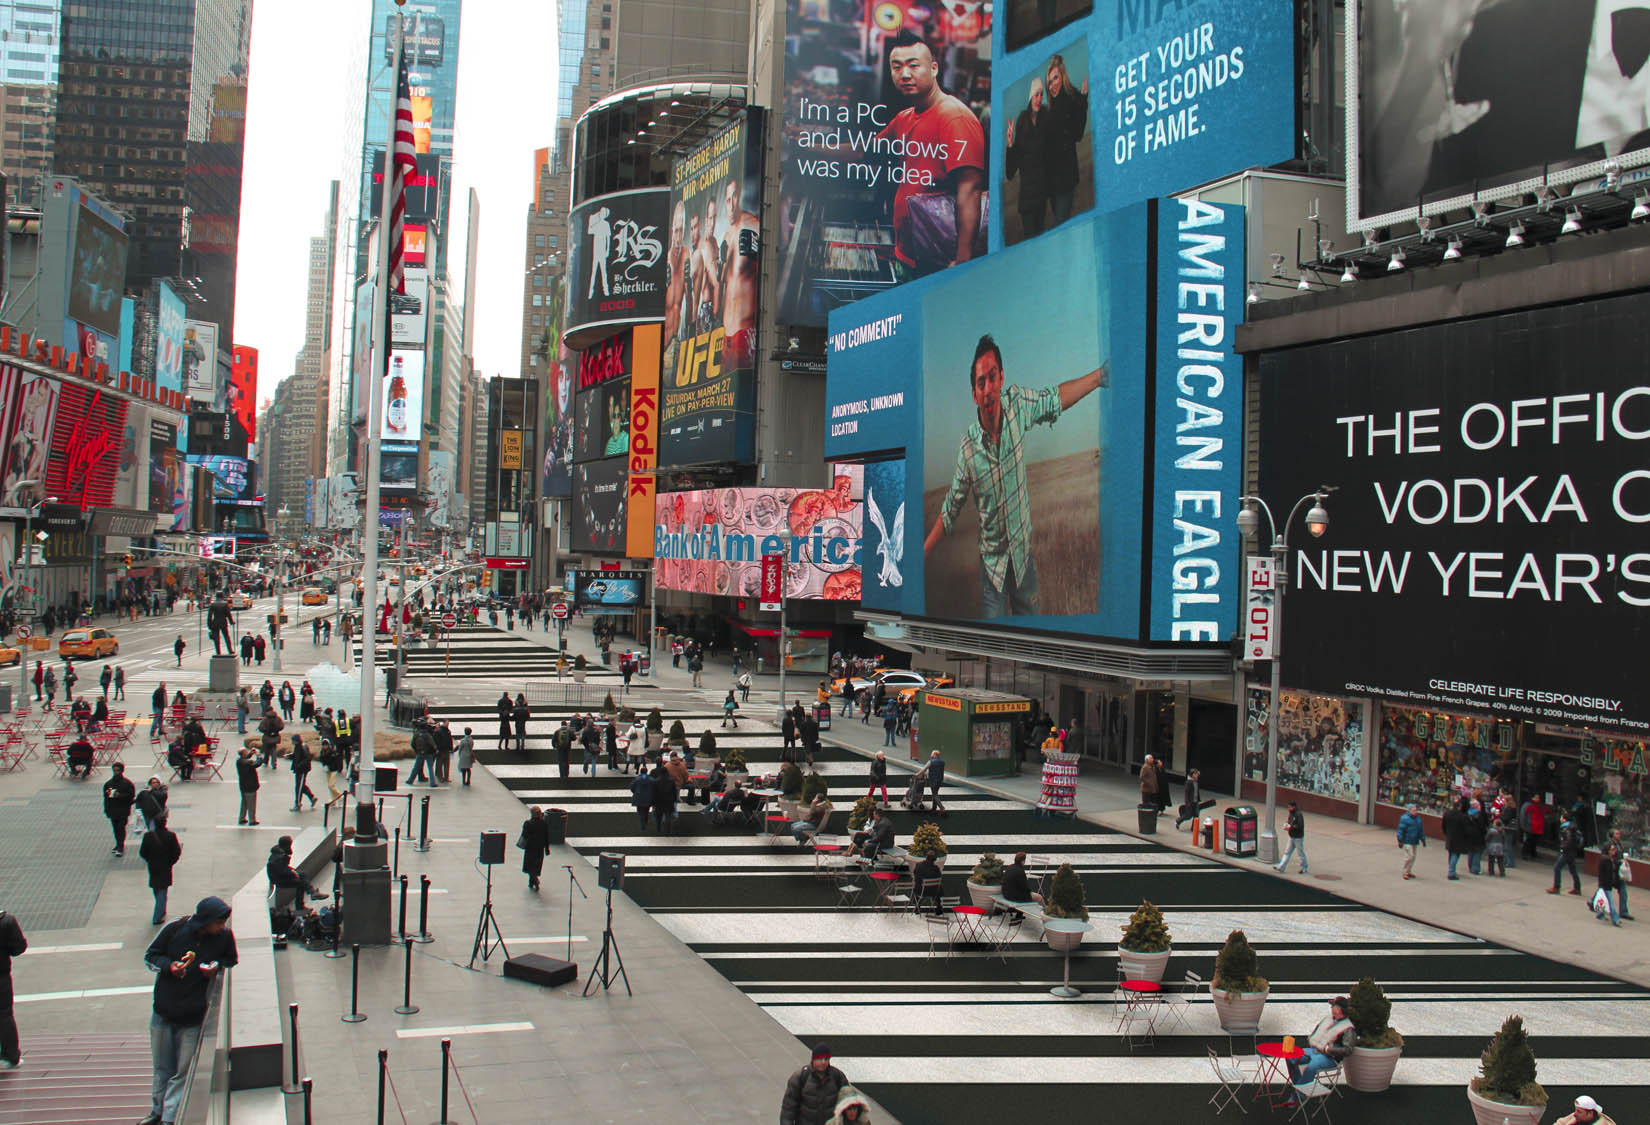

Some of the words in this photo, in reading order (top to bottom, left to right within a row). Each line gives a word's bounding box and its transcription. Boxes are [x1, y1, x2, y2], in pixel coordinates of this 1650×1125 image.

[1115, 52, 1150, 94] GET
[1157, 22, 1214, 73] YOUR
[1115, 95, 1137, 129] 15
[1144, 46, 1244, 116] SECONDS
[800, 97, 829, 121] I'm
[836, 106, 849, 123] a
[857, 103, 887, 126] PC
[675, 146, 710, 184] ST-PIERRE
[714, 125, 741, 158] HARDY
[797, 128, 840, 150] and
[848, 129, 949, 160] Windows
[954, 139, 968, 161] 7
[1114, 131, 1137, 165] OF
[1144, 104, 1206, 154] FAME.
[682, 180, 697, 201] MIR
[700, 157, 730, 191] CARWIN
[797, 159, 840, 178] was
[847, 163, 882, 187] my
[887, 161, 936, 187] idea.
[612, 281, 656, 295] Sheckler
[1174, 198, 1226, 471] AMERICAN
[577, 335, 625, 389] Kodak
[675, 327, 726, 387] UFC
[662, 406, 675, 420] LIVE
[676, 403, 686, 415] ON
[687, 392, 735, 412] PAY-PER-VIEW
[665, 389, 696, 406] SATURDAY,
[697, 383, 721, 397] MARCH
[721, 378, 732, 392] 27
[831, 399, 870, 419] ANONYMOUS,
[870, 391, 904, 411] UNKNOWN
[223, 413, 231, 440] 1500
[630, 387, 656, 497] Kodak
[831, 420, 858, 437] LOCATION
[1336, 408, 1441, 457] THE
[503, 455, 520, 463] KING
[1373, 474, 1589, 525] VODKA
[655, 525, 689, 559] Bank
[690, 524, 707, 560] of
[1171, 490, 1222, 642] EAGLE
[1297, 550, 1412, 594] NEW
[1428, 552, 1650, 607] YEAR'S
[978, 702, 1027, 712] NEWSSTAND
[1386, 688, 1408, 697] Distilled
[1409, 691, 1426, 700] From
[1427, 694, 1441, 702] Fine
[1442, 696, 1464, 705] French
[1543, 708, 1563, 717] 2009
[1564, 711, 1598, 723] Imported
[1600, 716, 1618, 725] from
[1620, 718, 1649, 729] France
[1429, 679, 1496, 696] CELEBRATE
[1499, 686, 1524, 699] LIFE
[1527, 690, 1623, 712] RESPONSIBLY.
[1414, 713, 1514, 752] GRAND
